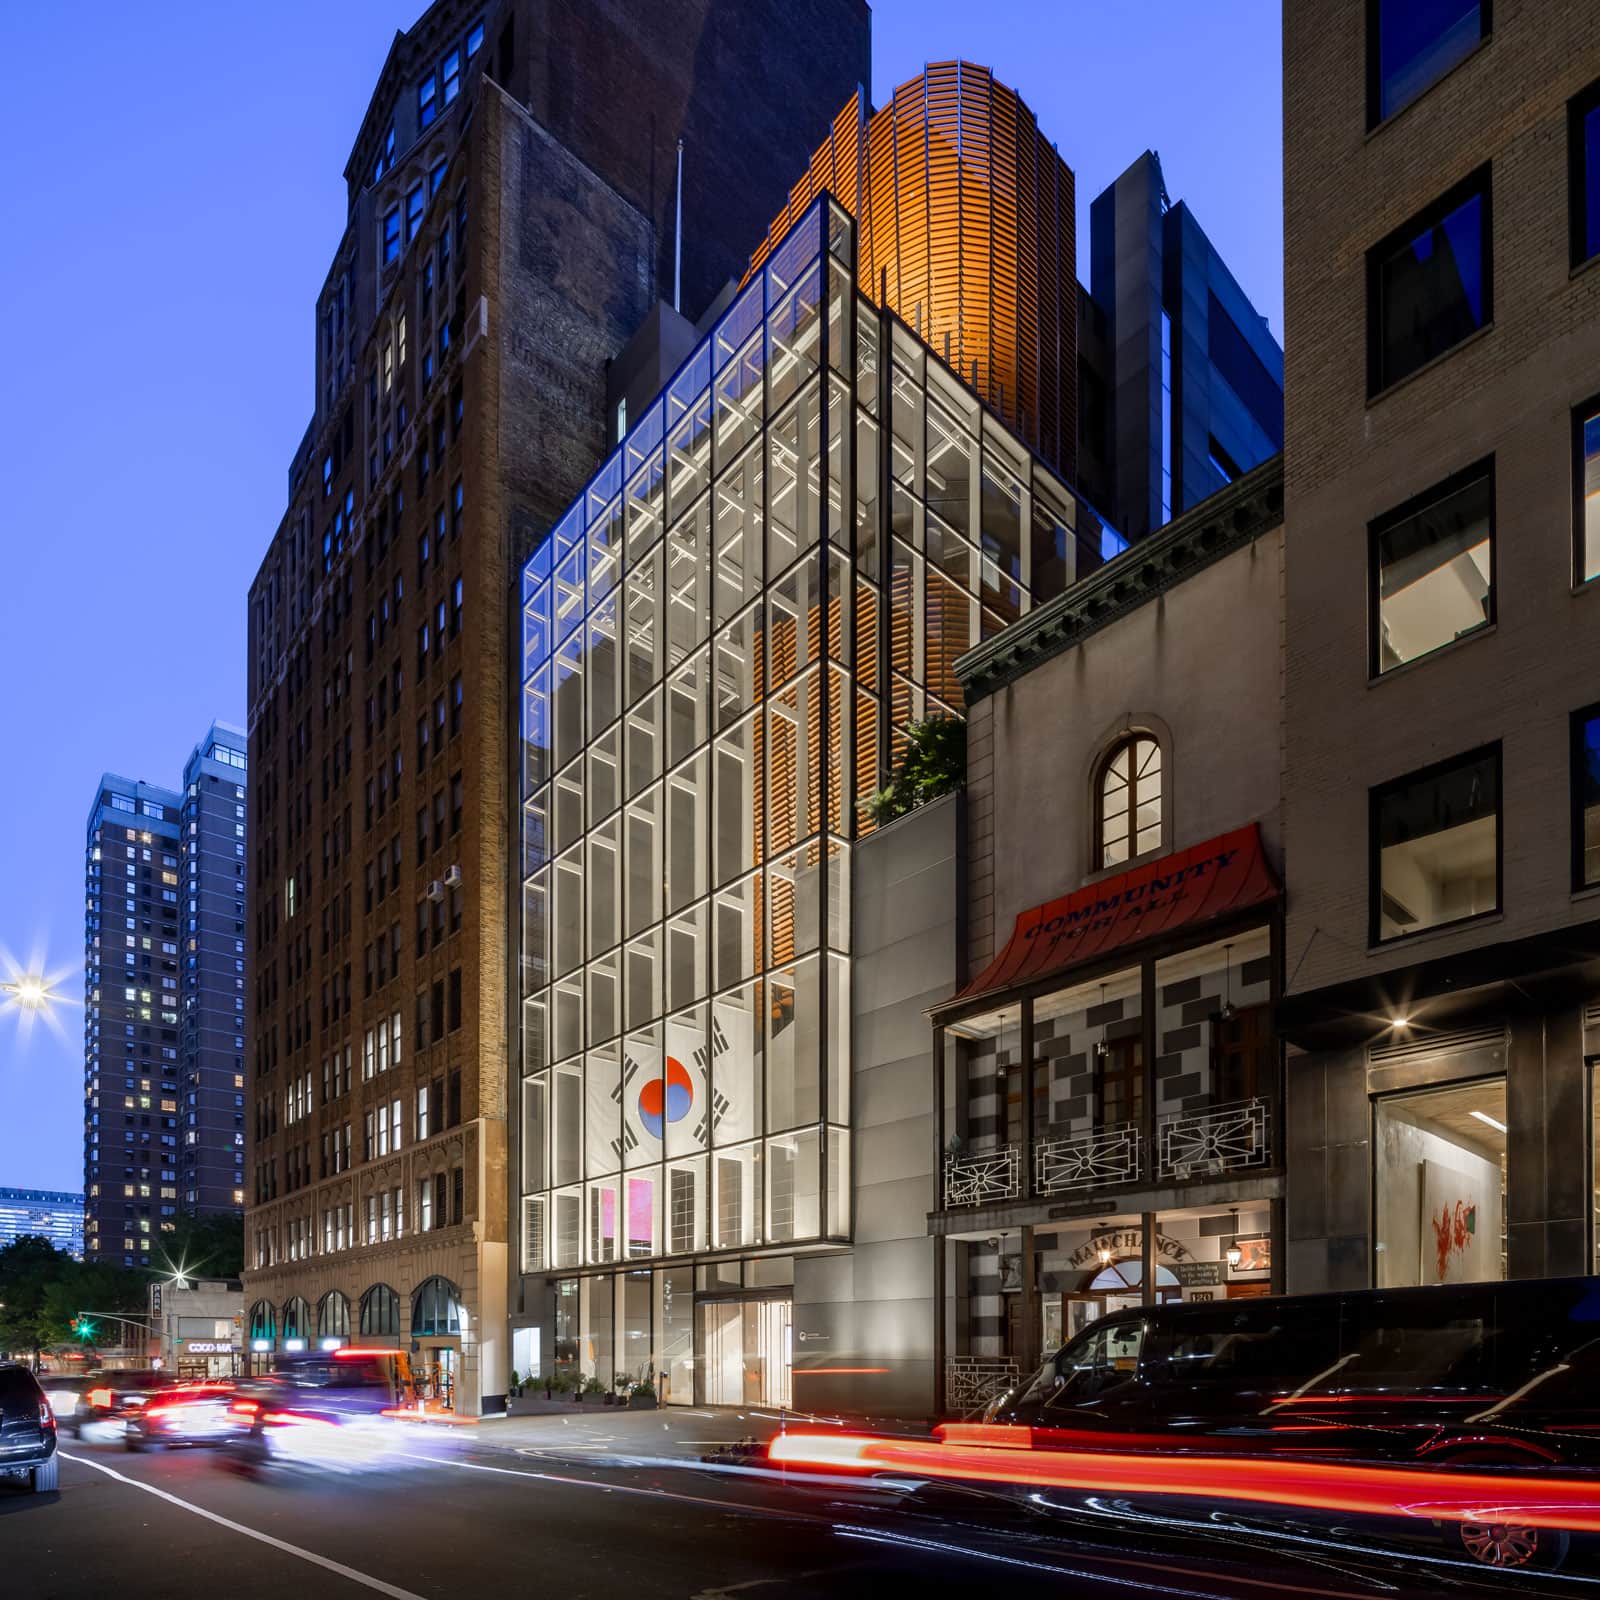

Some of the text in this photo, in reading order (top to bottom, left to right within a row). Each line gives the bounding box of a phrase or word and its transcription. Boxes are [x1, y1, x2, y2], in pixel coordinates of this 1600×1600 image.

[1025, 848, 1240, 940] COMMUNITY
[1050, 891, 1189, 947] FOR ALL
